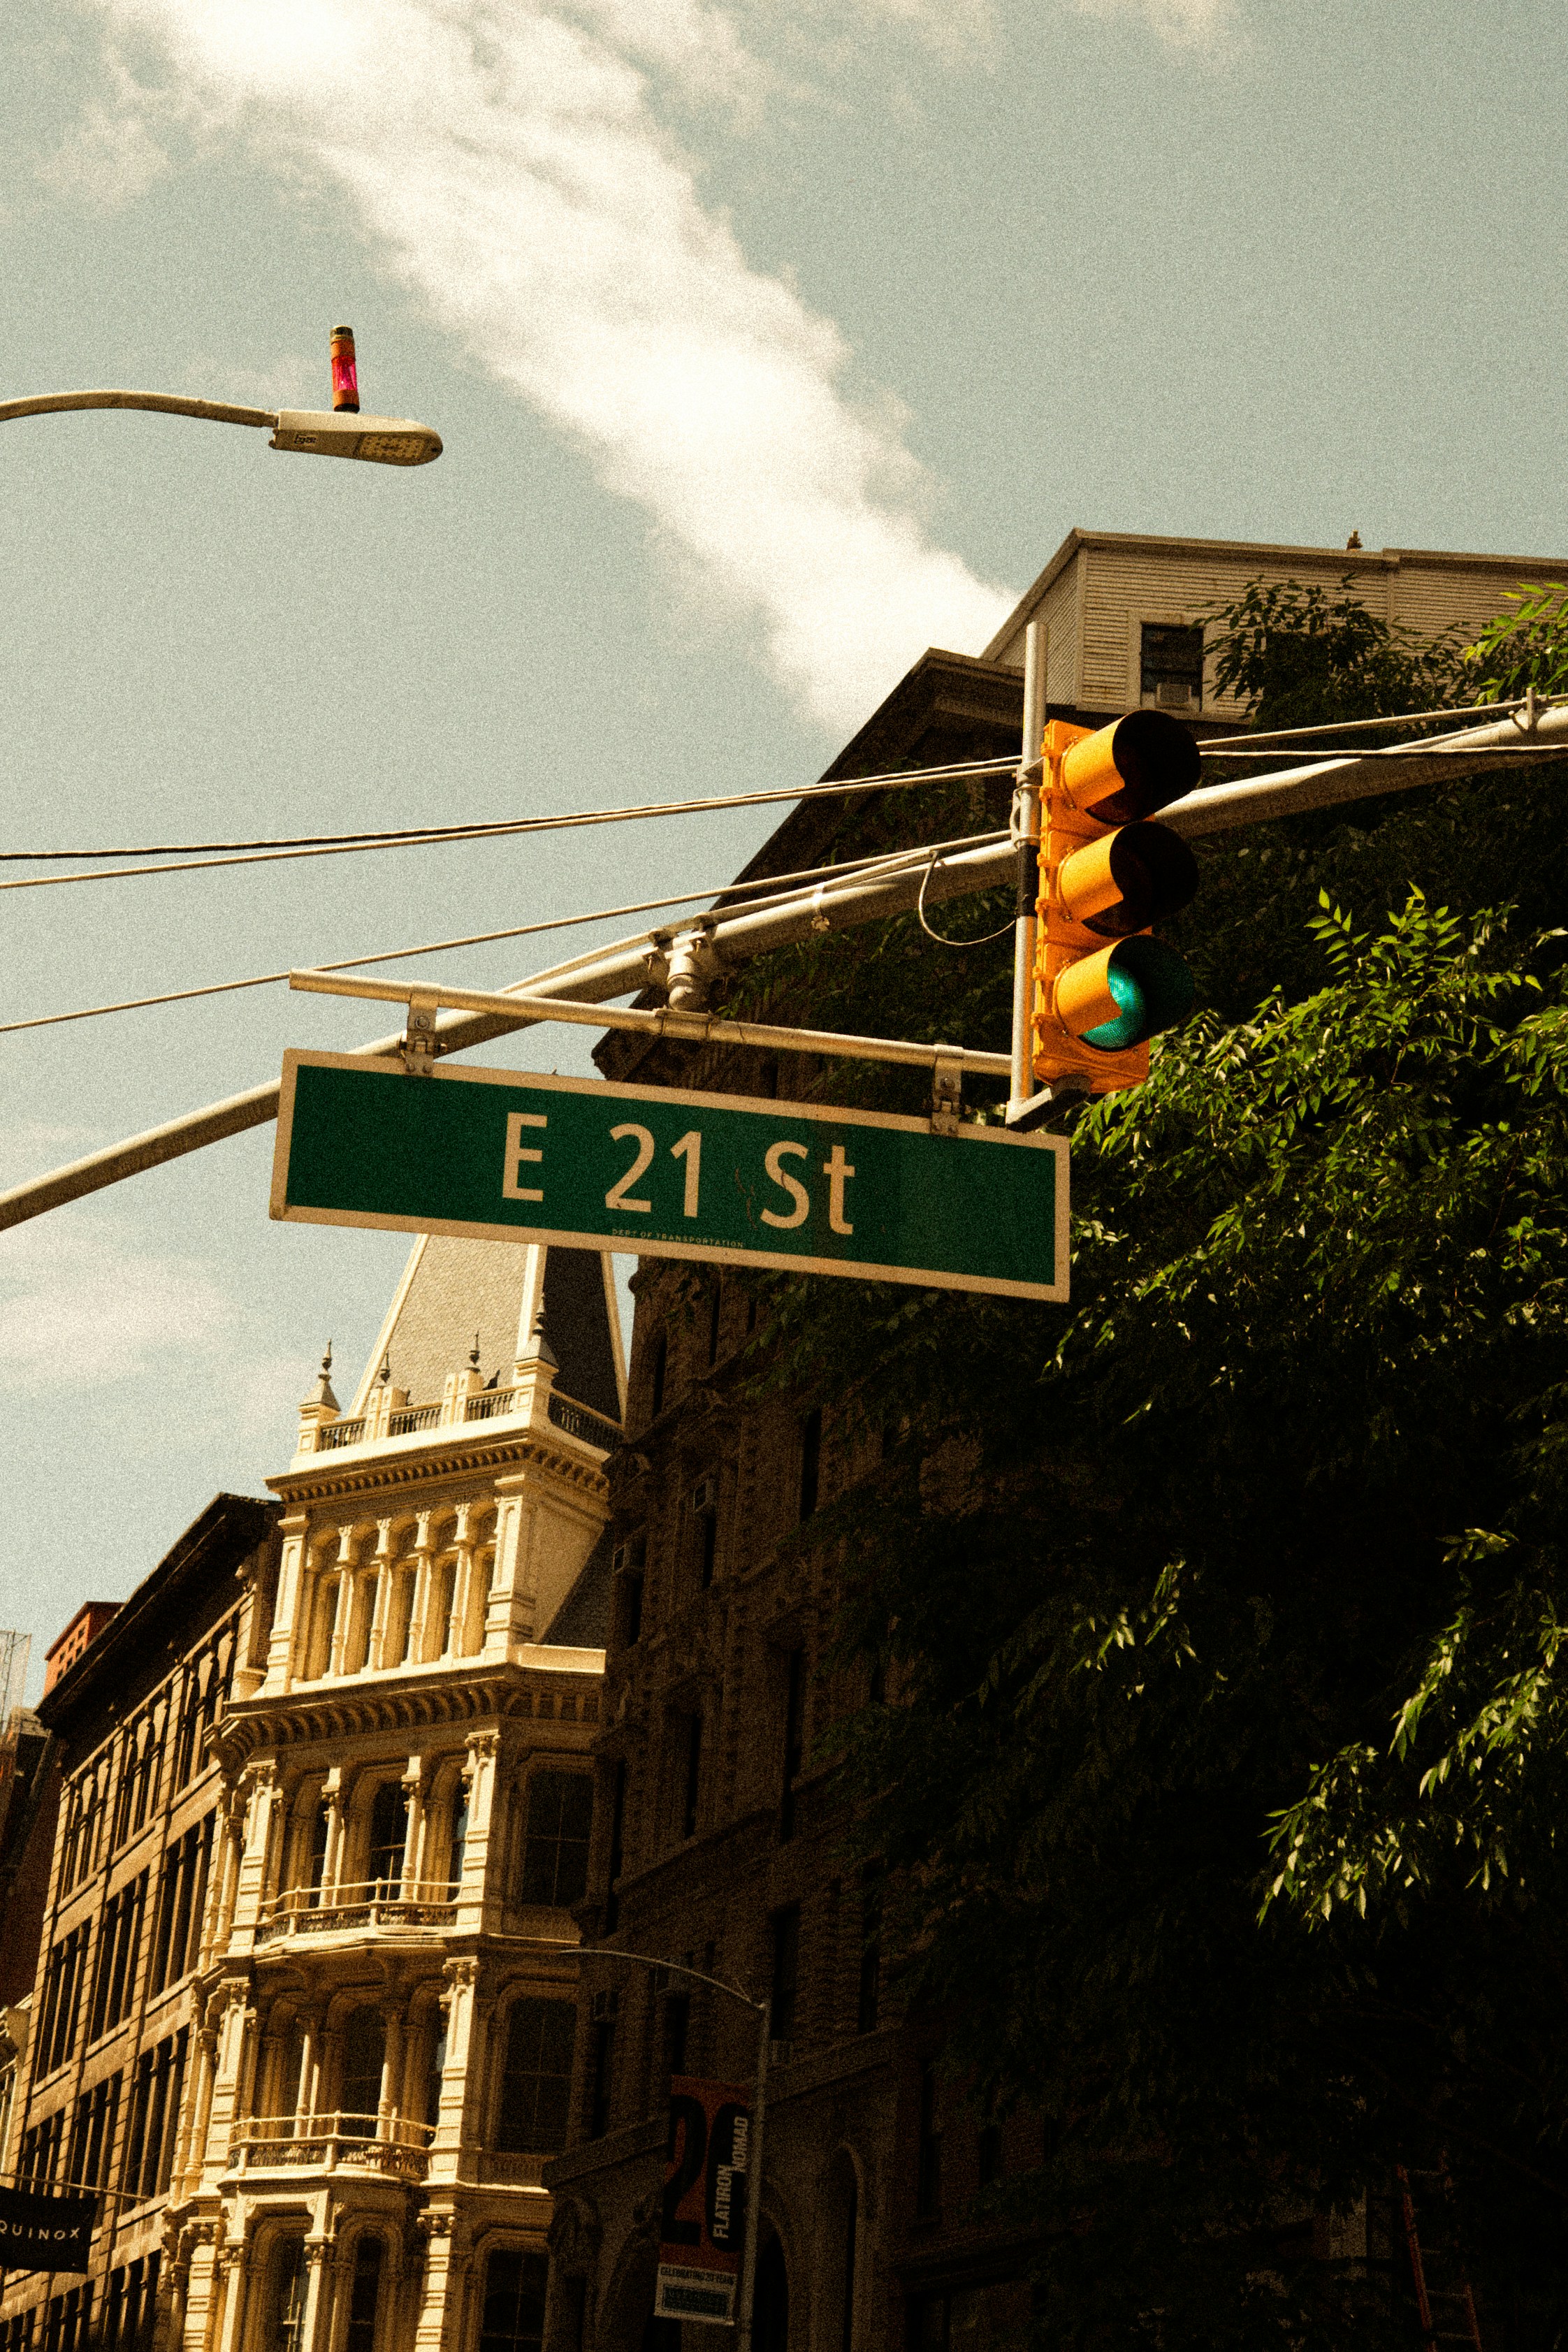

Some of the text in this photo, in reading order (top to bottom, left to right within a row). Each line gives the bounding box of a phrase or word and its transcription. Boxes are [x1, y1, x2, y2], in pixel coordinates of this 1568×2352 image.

[502, 1112, 856, 1235] E 21 St
[611, 1228, 637, 1237] DEPT
[655, 1233, 745, 1249] TRANSPORTATION
[660, 2093, 750, 2252] 20
[732, 2115, 749, 2173] NOMAD
[712, 2164, 733, 2240] FLATIRON
